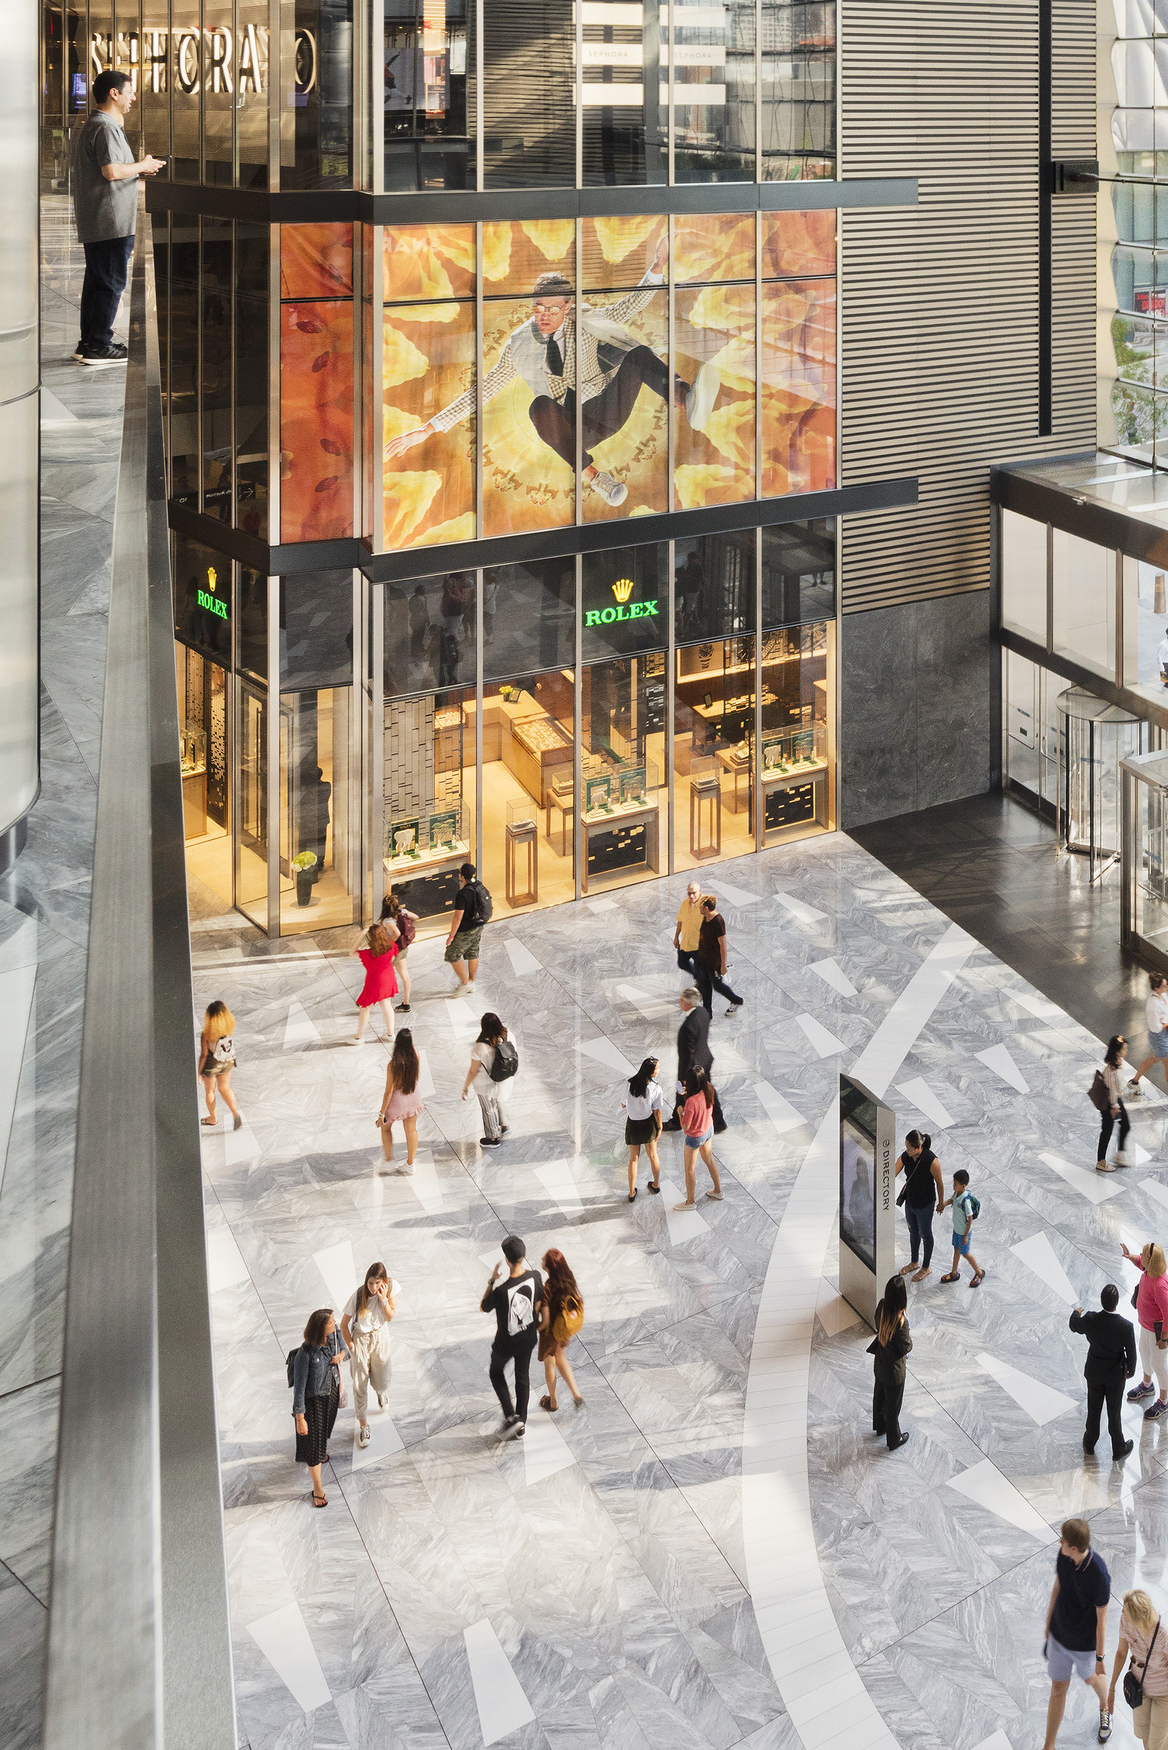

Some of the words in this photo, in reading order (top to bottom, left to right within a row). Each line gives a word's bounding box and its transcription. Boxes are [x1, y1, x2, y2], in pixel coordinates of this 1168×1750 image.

[588, 50, 629, 58] SEPHORA
[197, 589, 228, 620] ROLEX
[585, 599, 660, 627] ROLEX
[882, 1150, 890, 1211] DIRECTORY
